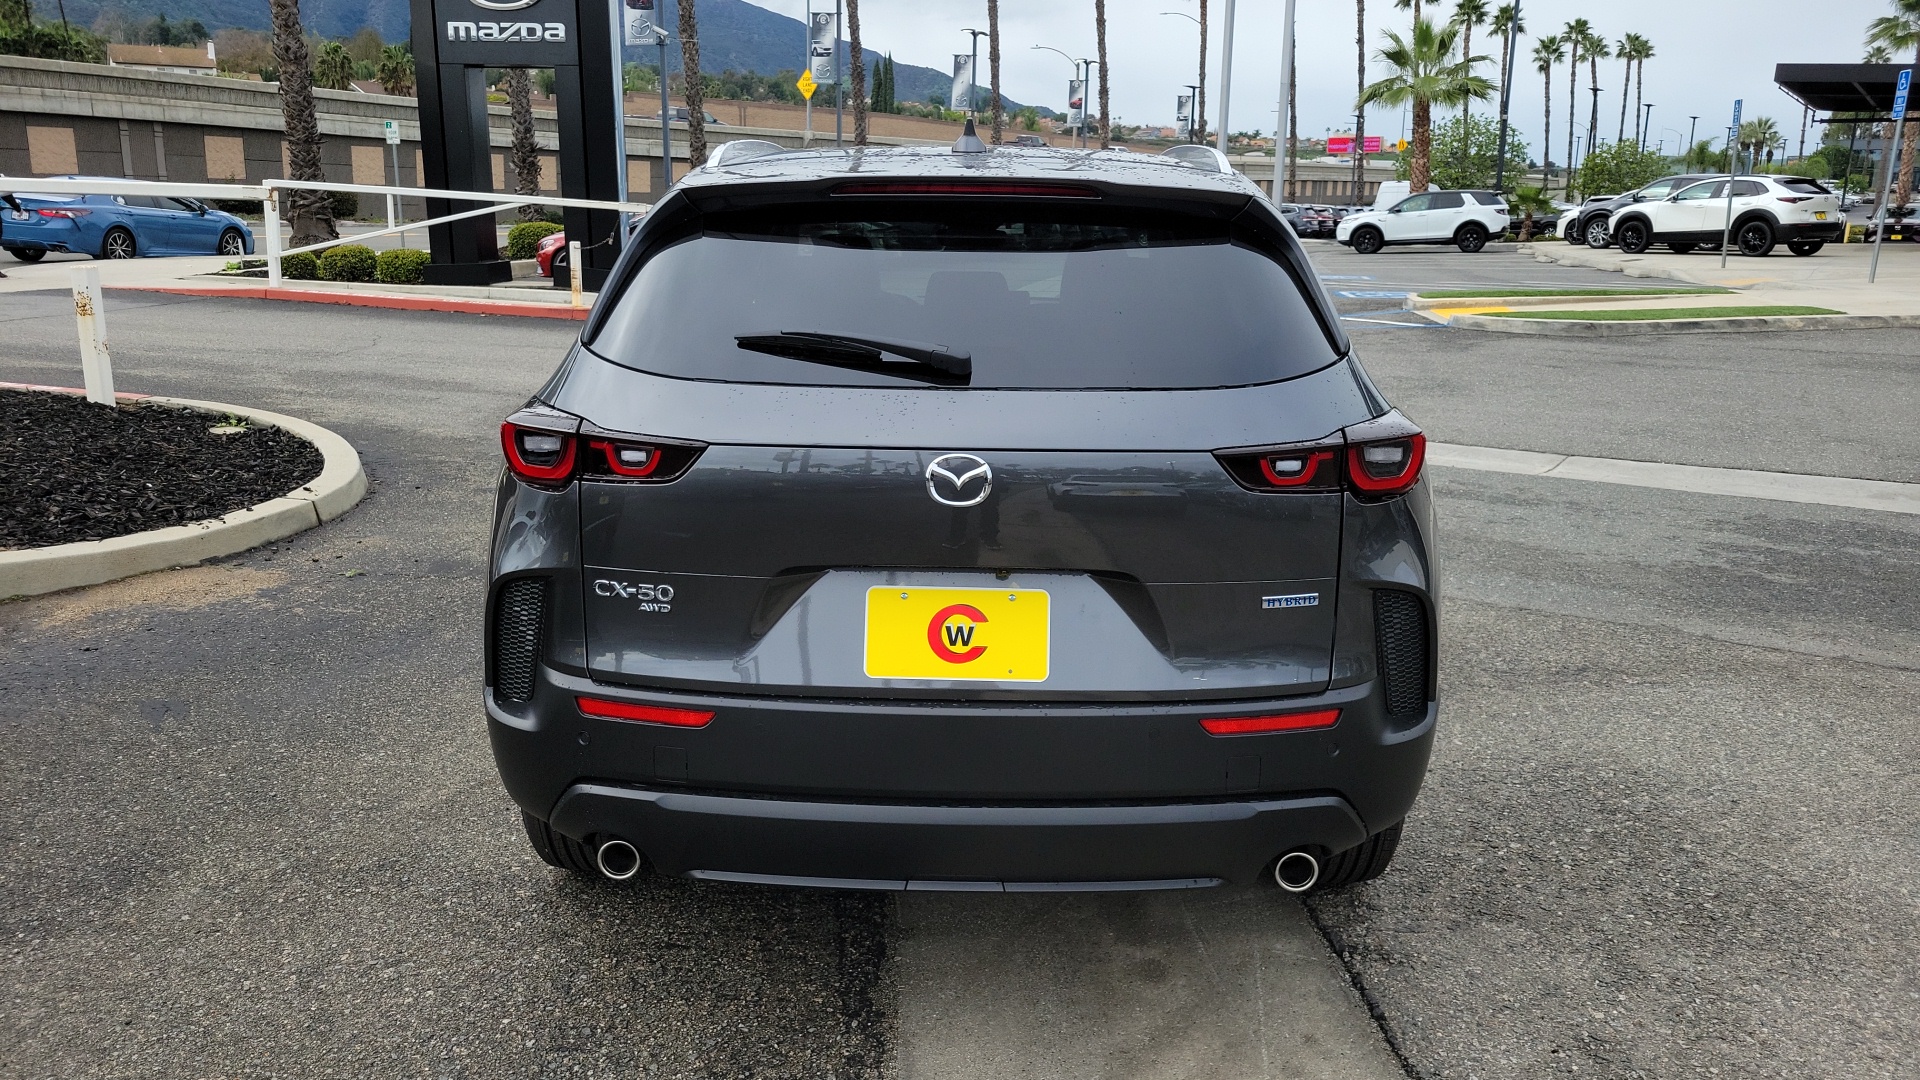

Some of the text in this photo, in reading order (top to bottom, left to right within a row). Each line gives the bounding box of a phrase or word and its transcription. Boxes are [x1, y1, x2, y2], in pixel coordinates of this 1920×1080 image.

[593, 579, 674, 602] CX-50
[1267, 596, 1316, 607] HYBRID
[638, 602, 671, 613] AWD
